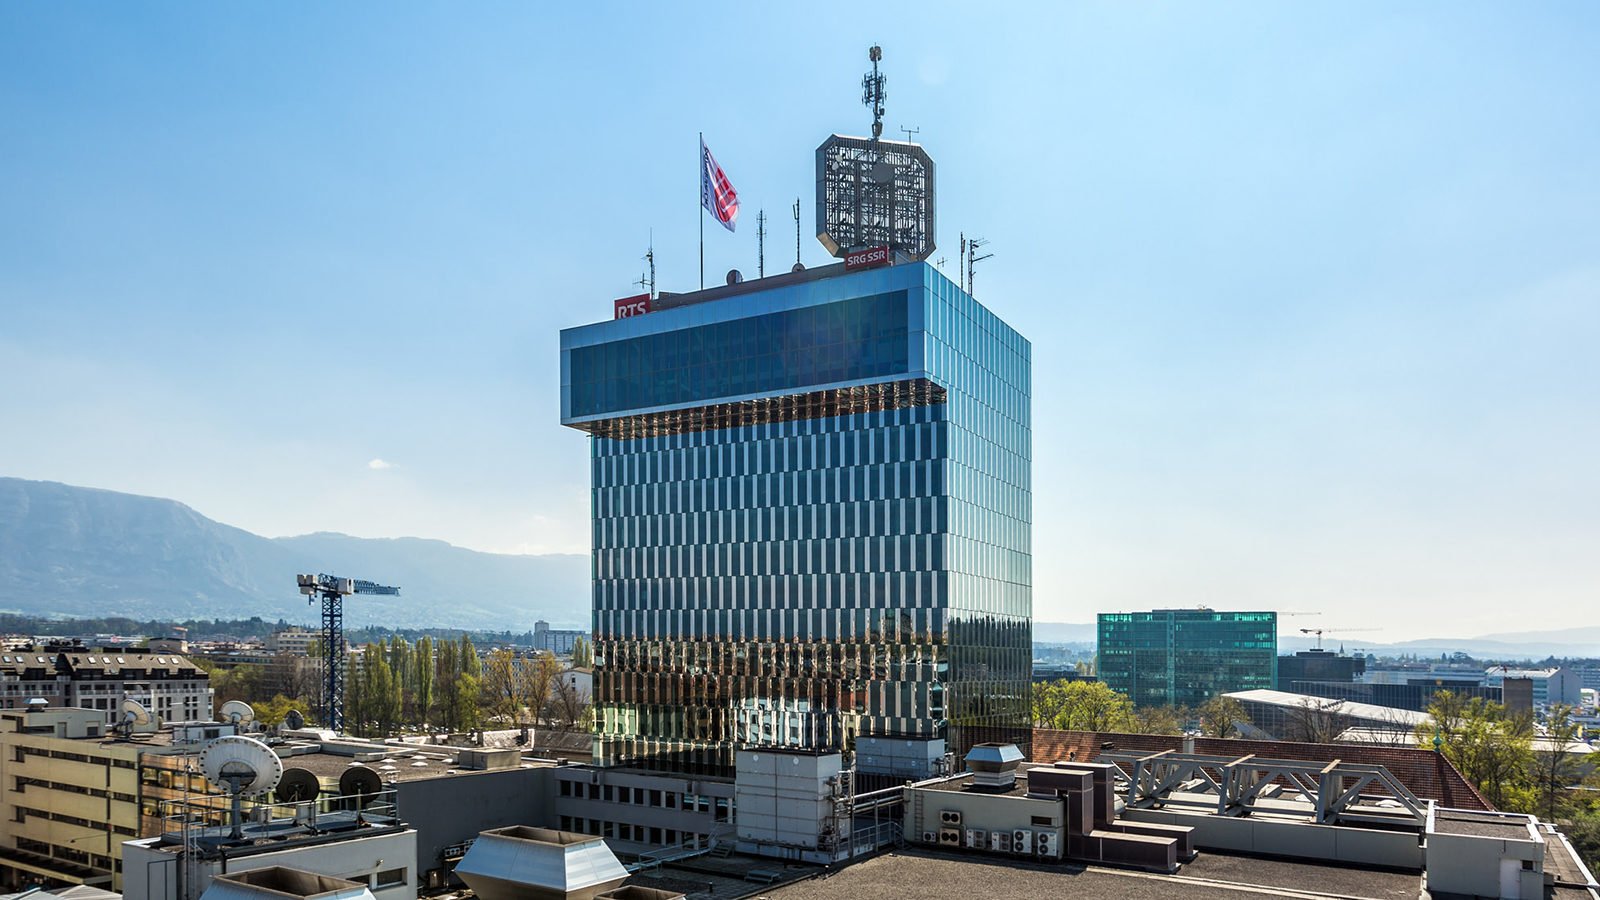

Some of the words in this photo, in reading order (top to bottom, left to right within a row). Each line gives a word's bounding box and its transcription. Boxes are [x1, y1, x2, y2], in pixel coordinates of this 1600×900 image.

[848, 254, 866, 266] SRG
[867, 250, 885, 262] SSR
[618, 302, 646, 319] RTS
